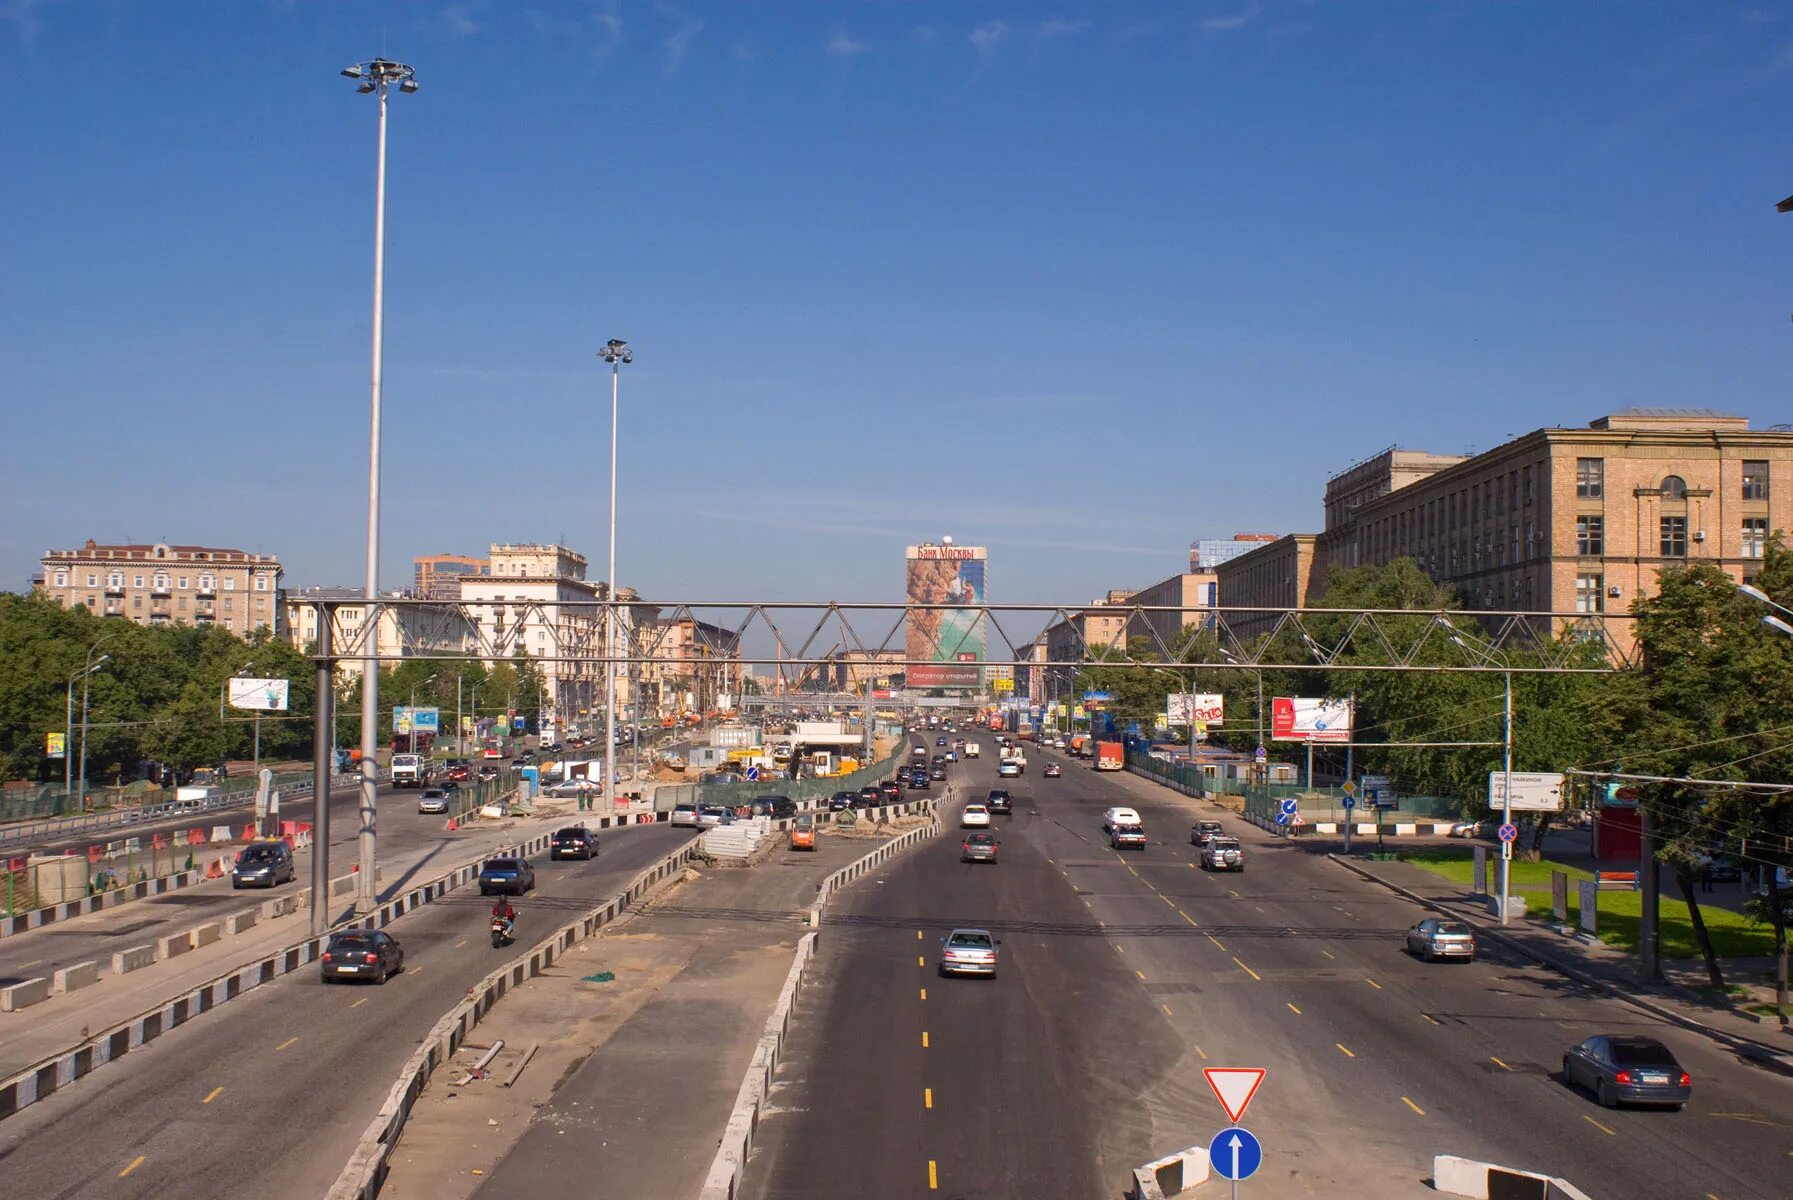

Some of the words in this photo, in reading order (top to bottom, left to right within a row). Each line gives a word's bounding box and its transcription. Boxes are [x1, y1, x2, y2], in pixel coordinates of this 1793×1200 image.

[918, 546, 937, 559] Банк
[940, 546, 974, 559] Москвы
[912, 672, 945, 680] Оператор
[945, 672, 977, 680] открытий
